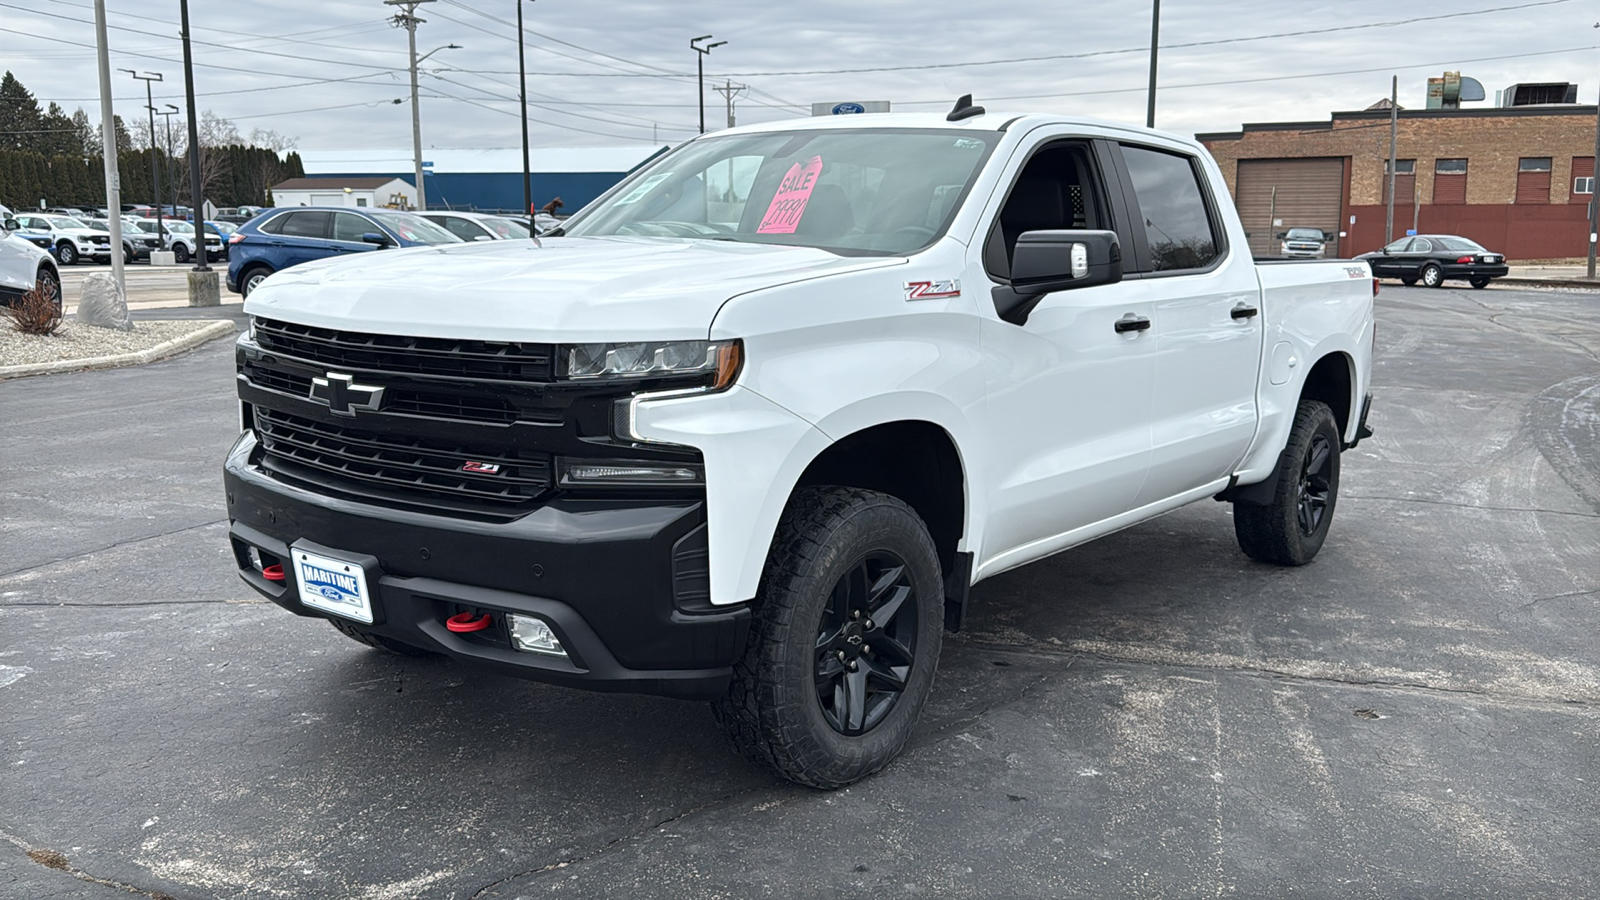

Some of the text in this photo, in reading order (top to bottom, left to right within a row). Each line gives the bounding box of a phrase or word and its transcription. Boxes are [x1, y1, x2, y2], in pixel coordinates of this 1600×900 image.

[838, 105, 857, 115] Ford
[778, 172, 815, 195] SALE
[903, 279, 961, 302] Z71
[462, 460, 500, 474] Z71
[302, 564, 359, 595] MARITIME
[323, 588, 340, 600] Ford
